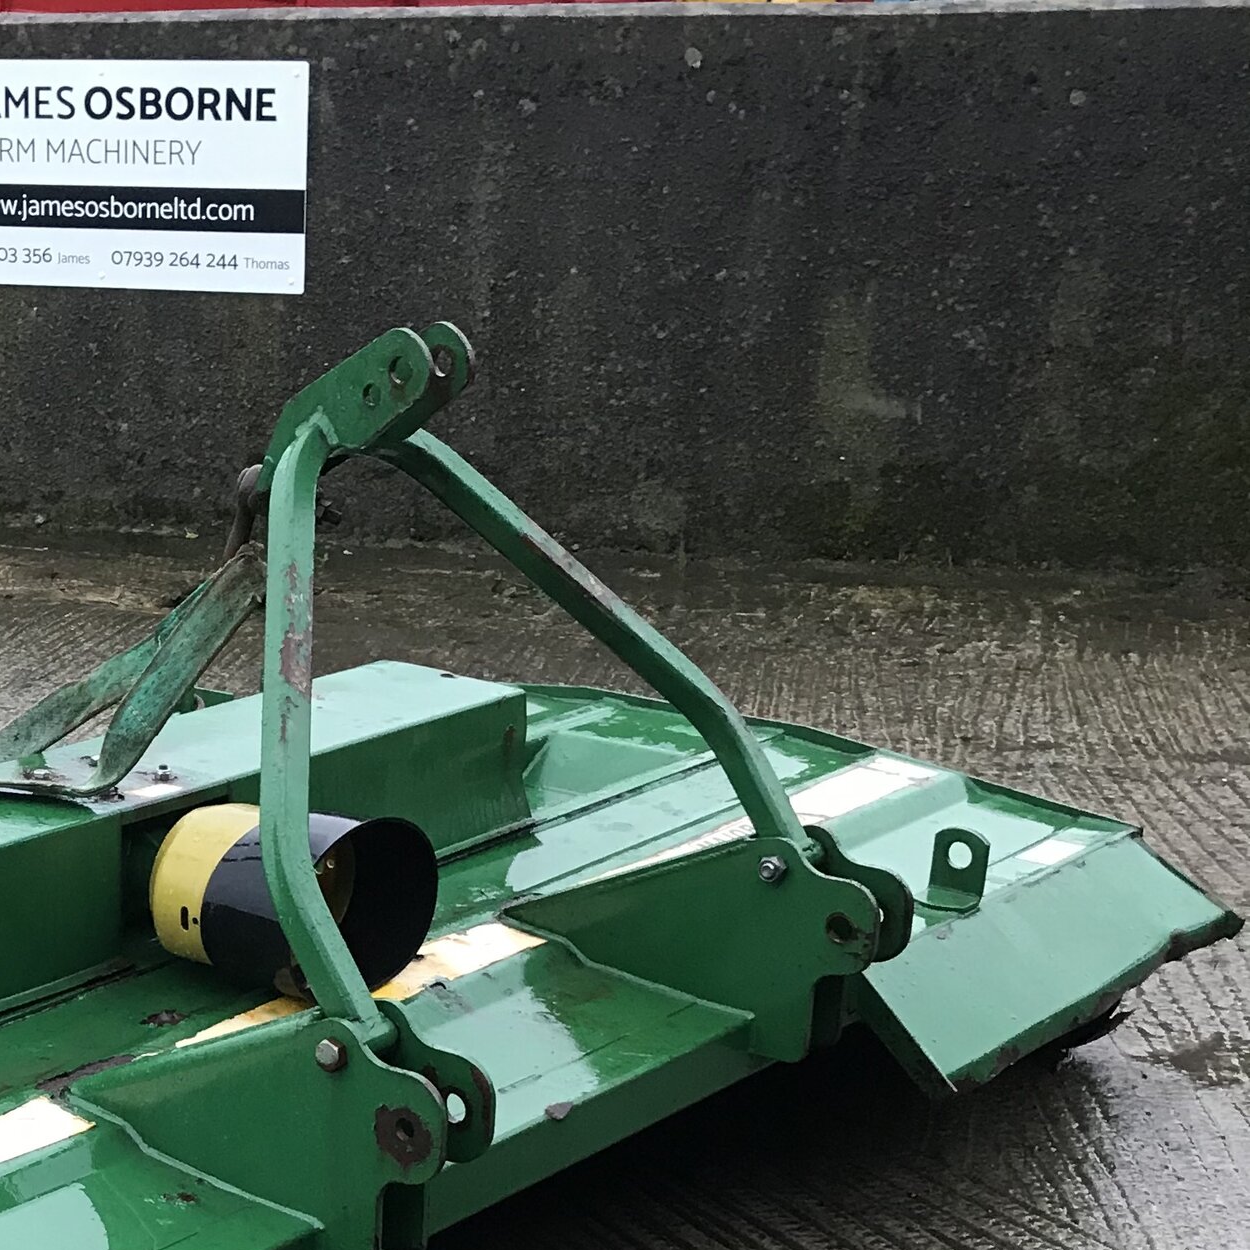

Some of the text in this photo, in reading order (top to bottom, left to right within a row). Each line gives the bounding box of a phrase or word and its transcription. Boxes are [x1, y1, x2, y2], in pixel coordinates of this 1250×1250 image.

[84, 86, 277, 122] OSBORNE
[46, 138, 202, 166] MACHINERY
[22, 247, 53, 264] 356
[57, 252, 91, 265] James
[111, 250, 290, 271] 07939 264 244 Thomas
